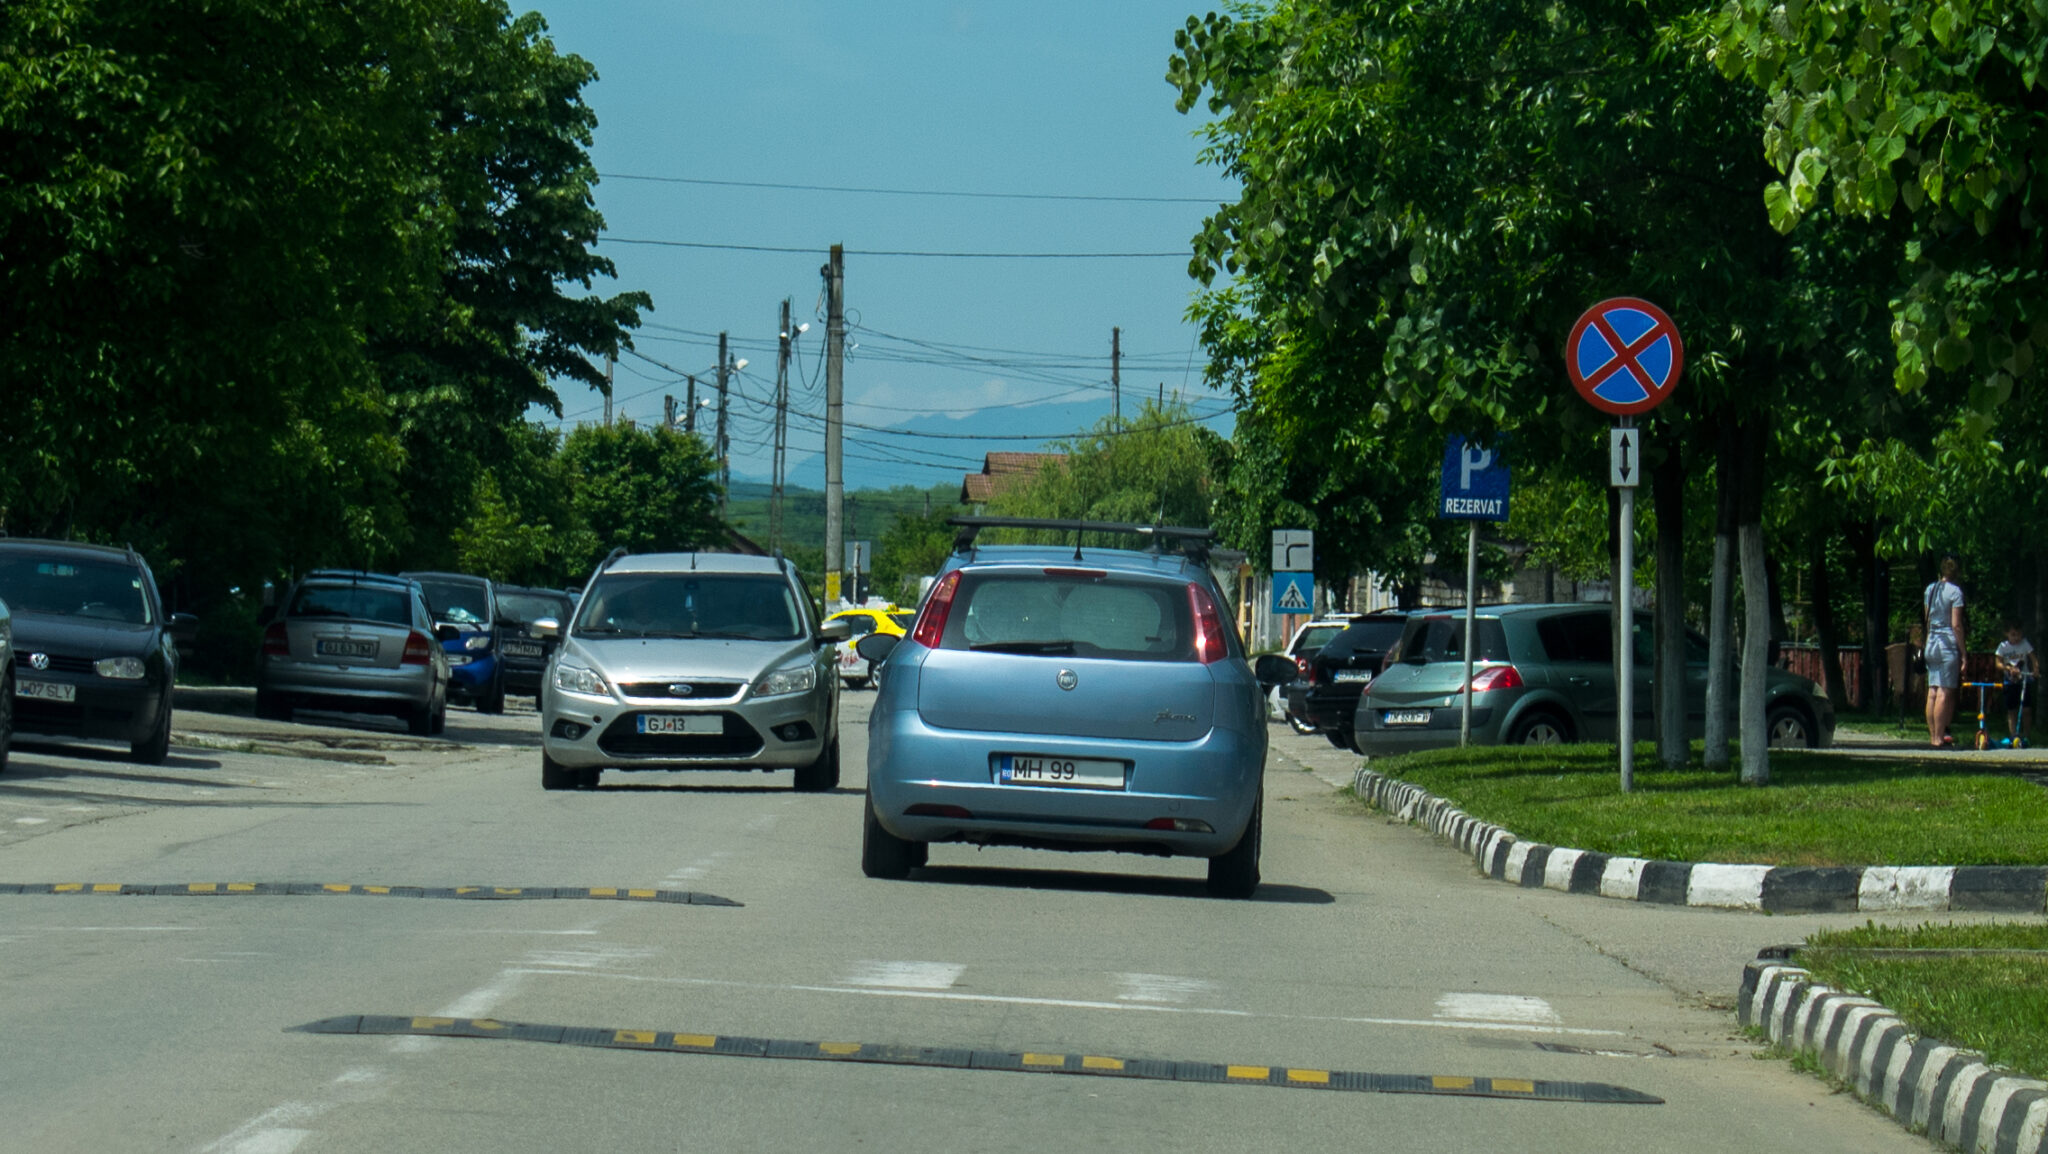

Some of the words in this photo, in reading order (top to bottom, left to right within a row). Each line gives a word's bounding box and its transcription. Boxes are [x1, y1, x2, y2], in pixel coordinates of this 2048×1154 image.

[1460, 441, 1491, 489] P
[1445, 497, 1503, 515] REZERVAT
[28, 682, 44, 696] 07
[46, 684, 73, 699] SLY
[648, 717, 667, 732] GJ
[672, 717, 685, 732] 13
[1014, 759, 1043, 779] MH
[1050, 761, 1075, 781] 99
